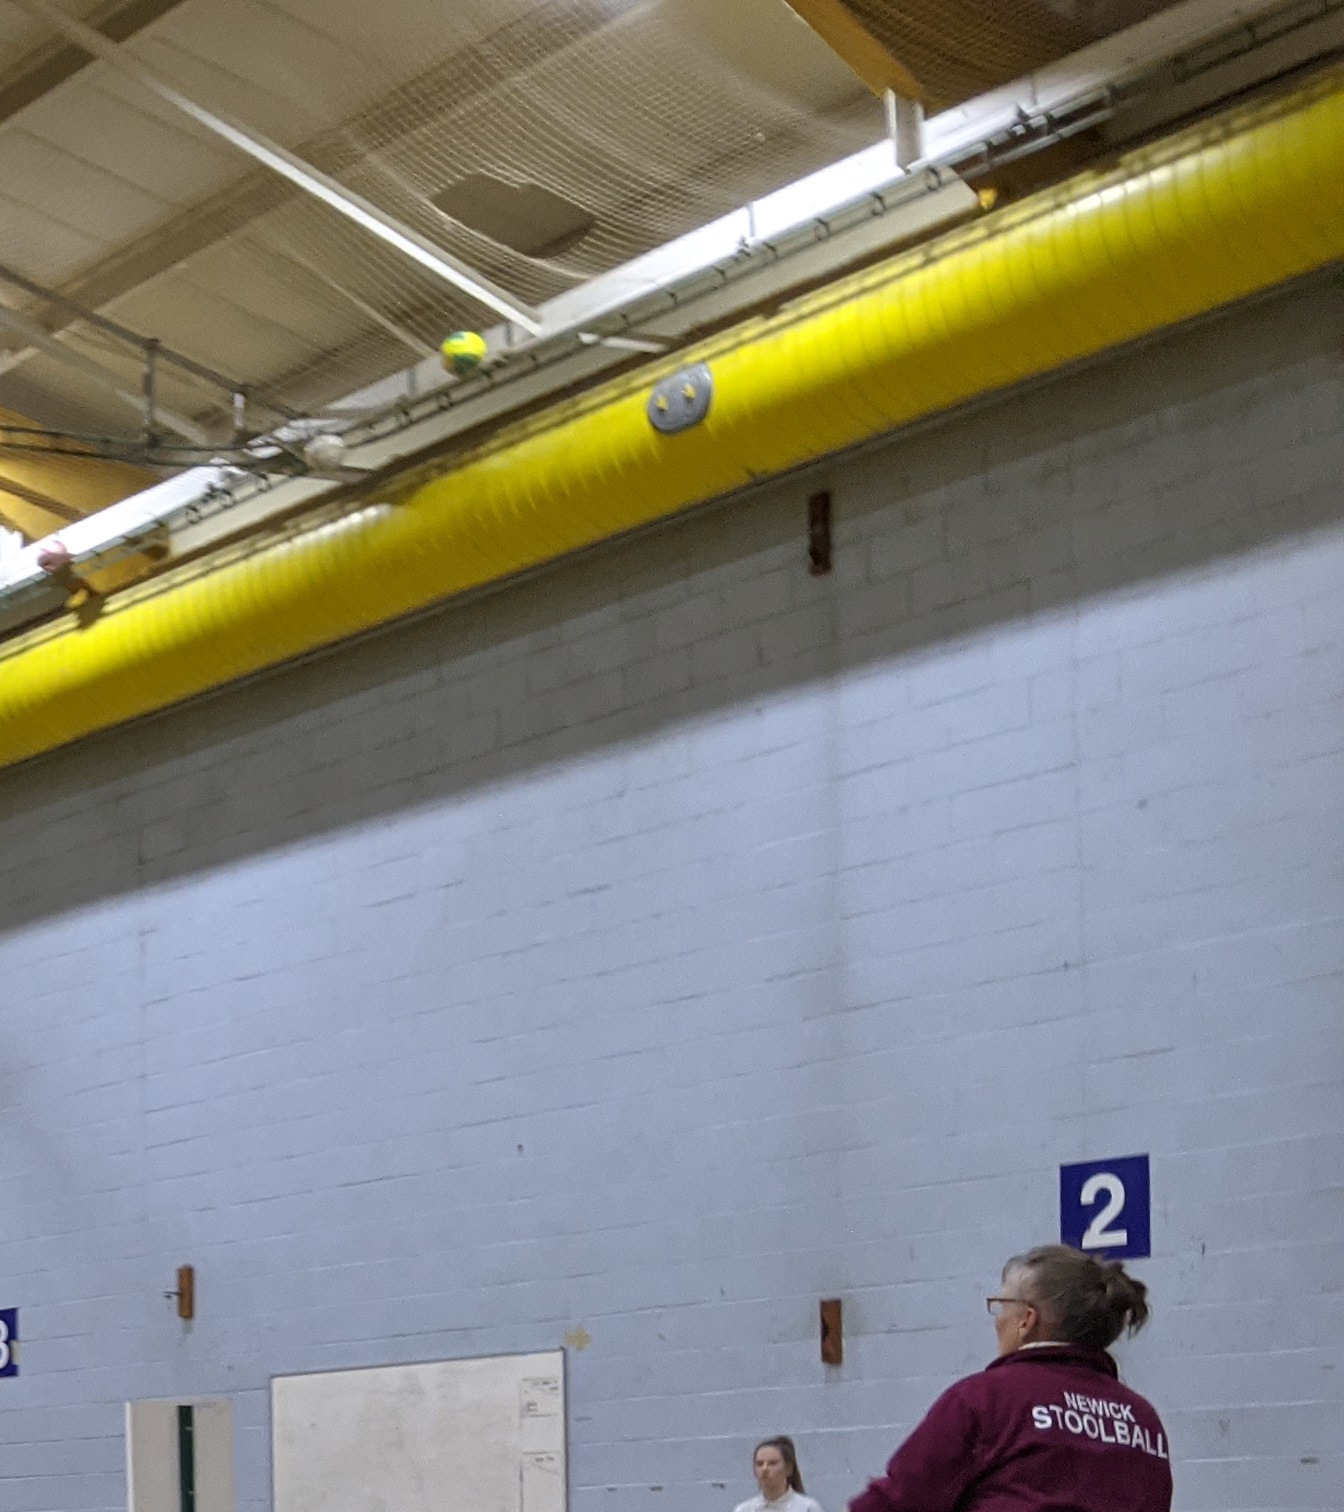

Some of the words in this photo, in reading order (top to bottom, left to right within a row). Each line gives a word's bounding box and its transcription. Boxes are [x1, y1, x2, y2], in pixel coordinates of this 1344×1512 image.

[1080, 1172, 1128, 1250] 2
[1032, 1404, 1168, 1459] STOOLBALL
[1063, 1391, 1136, 1423] NEWICK
